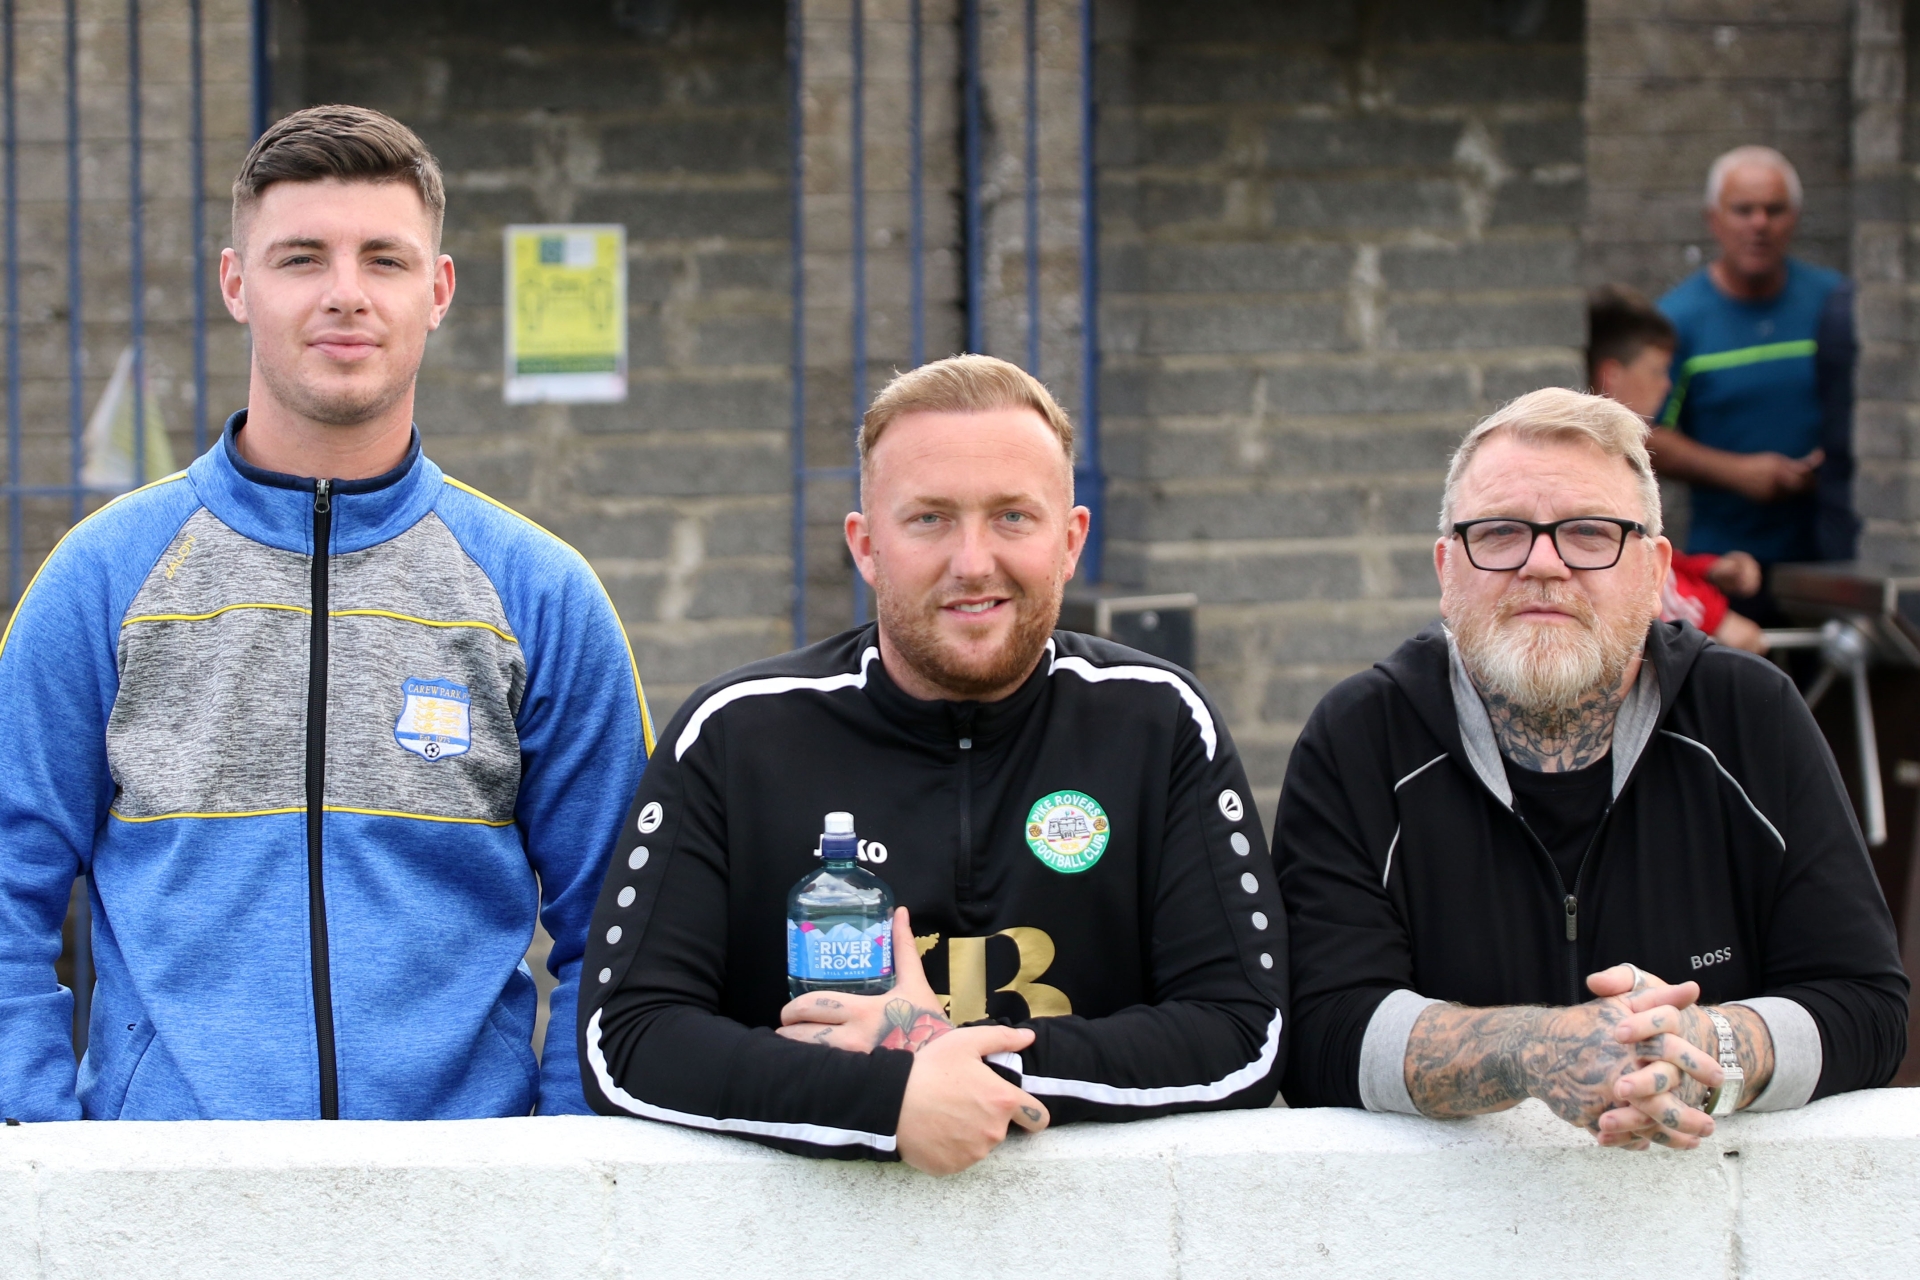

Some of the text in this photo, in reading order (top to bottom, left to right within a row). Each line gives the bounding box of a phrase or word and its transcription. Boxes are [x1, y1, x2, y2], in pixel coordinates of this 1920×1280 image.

[165, 534, 196, 580] BALON
[408, 684, 438, 695] CAREW
[440, 687, 462, 699] PARK
[1031, 794, 1102, 822] PIKE ROVERS
[813, 833, 888, 863] JKO
[1032, 834, 1106, 868] FOOTBALL CLUB
[820, 940, 872, 955] RIVER
[1690, 946, 1732, 970] BOSS
[820, 953, 873, 970] ROCK
